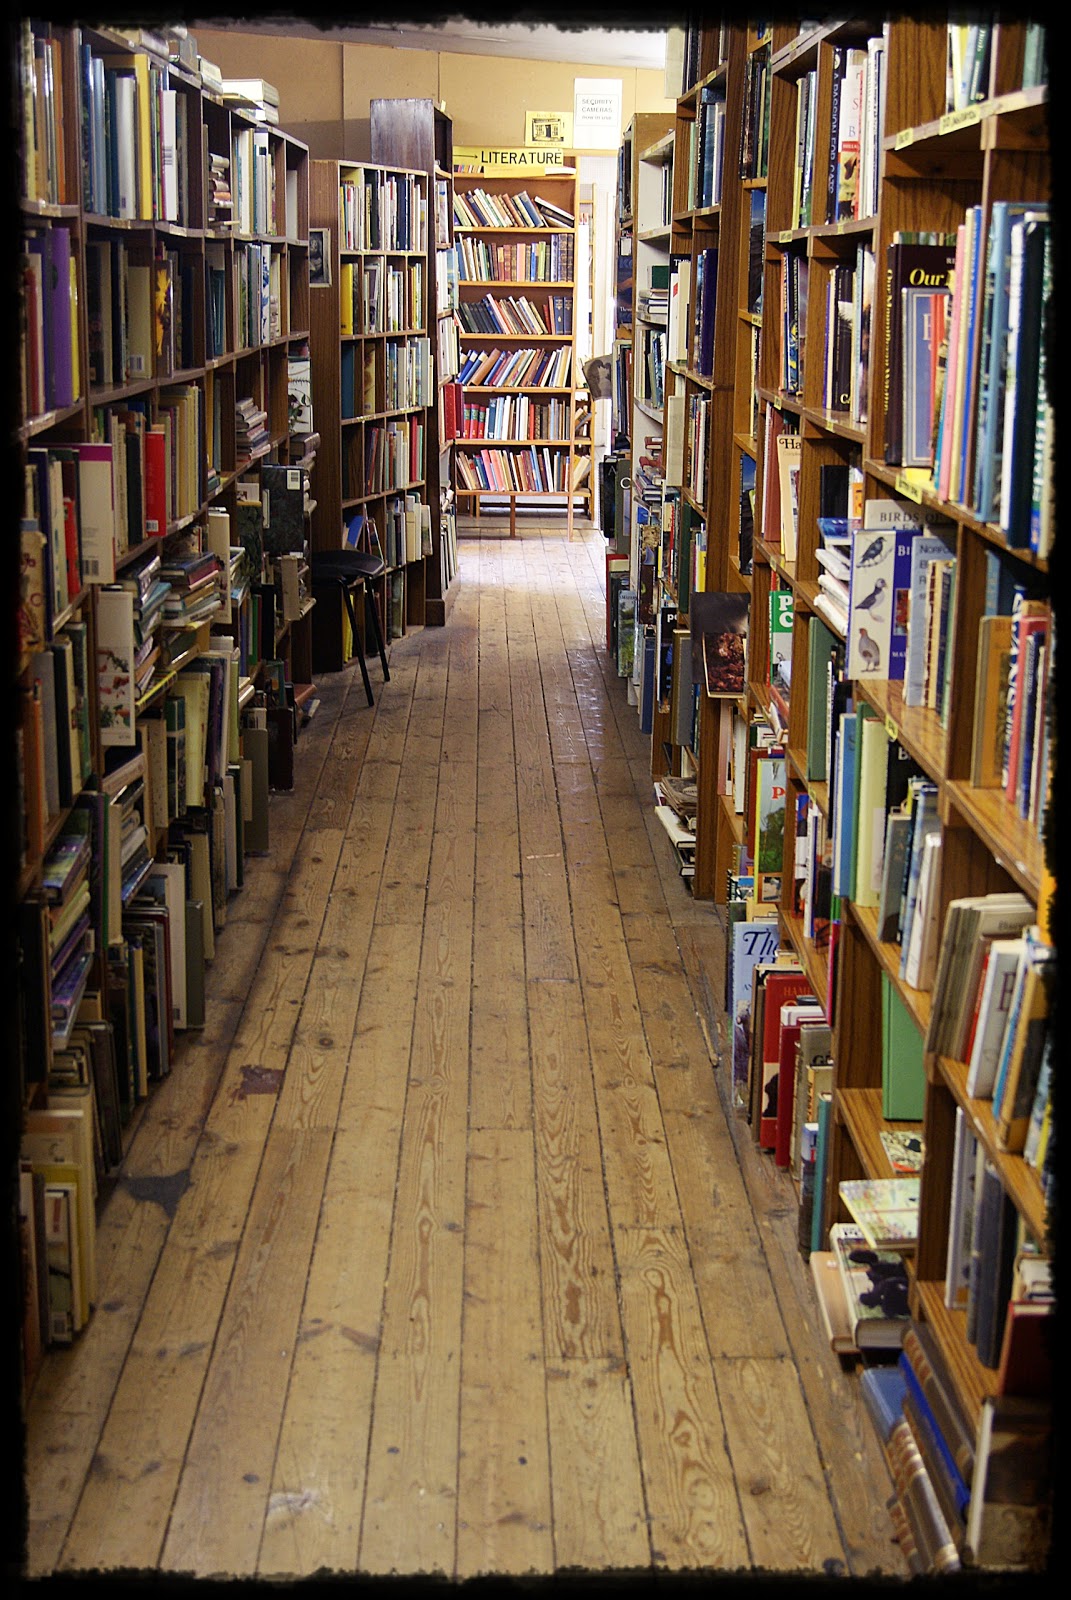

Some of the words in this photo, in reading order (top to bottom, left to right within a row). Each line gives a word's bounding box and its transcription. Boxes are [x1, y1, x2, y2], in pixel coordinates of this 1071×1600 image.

[581, 98, 613, 106] SECURITY
[481, 150, 562, 165] LITERATURE
[909, 268, 945, 288] Our
[879, 512, 920, 523] BIRDS
